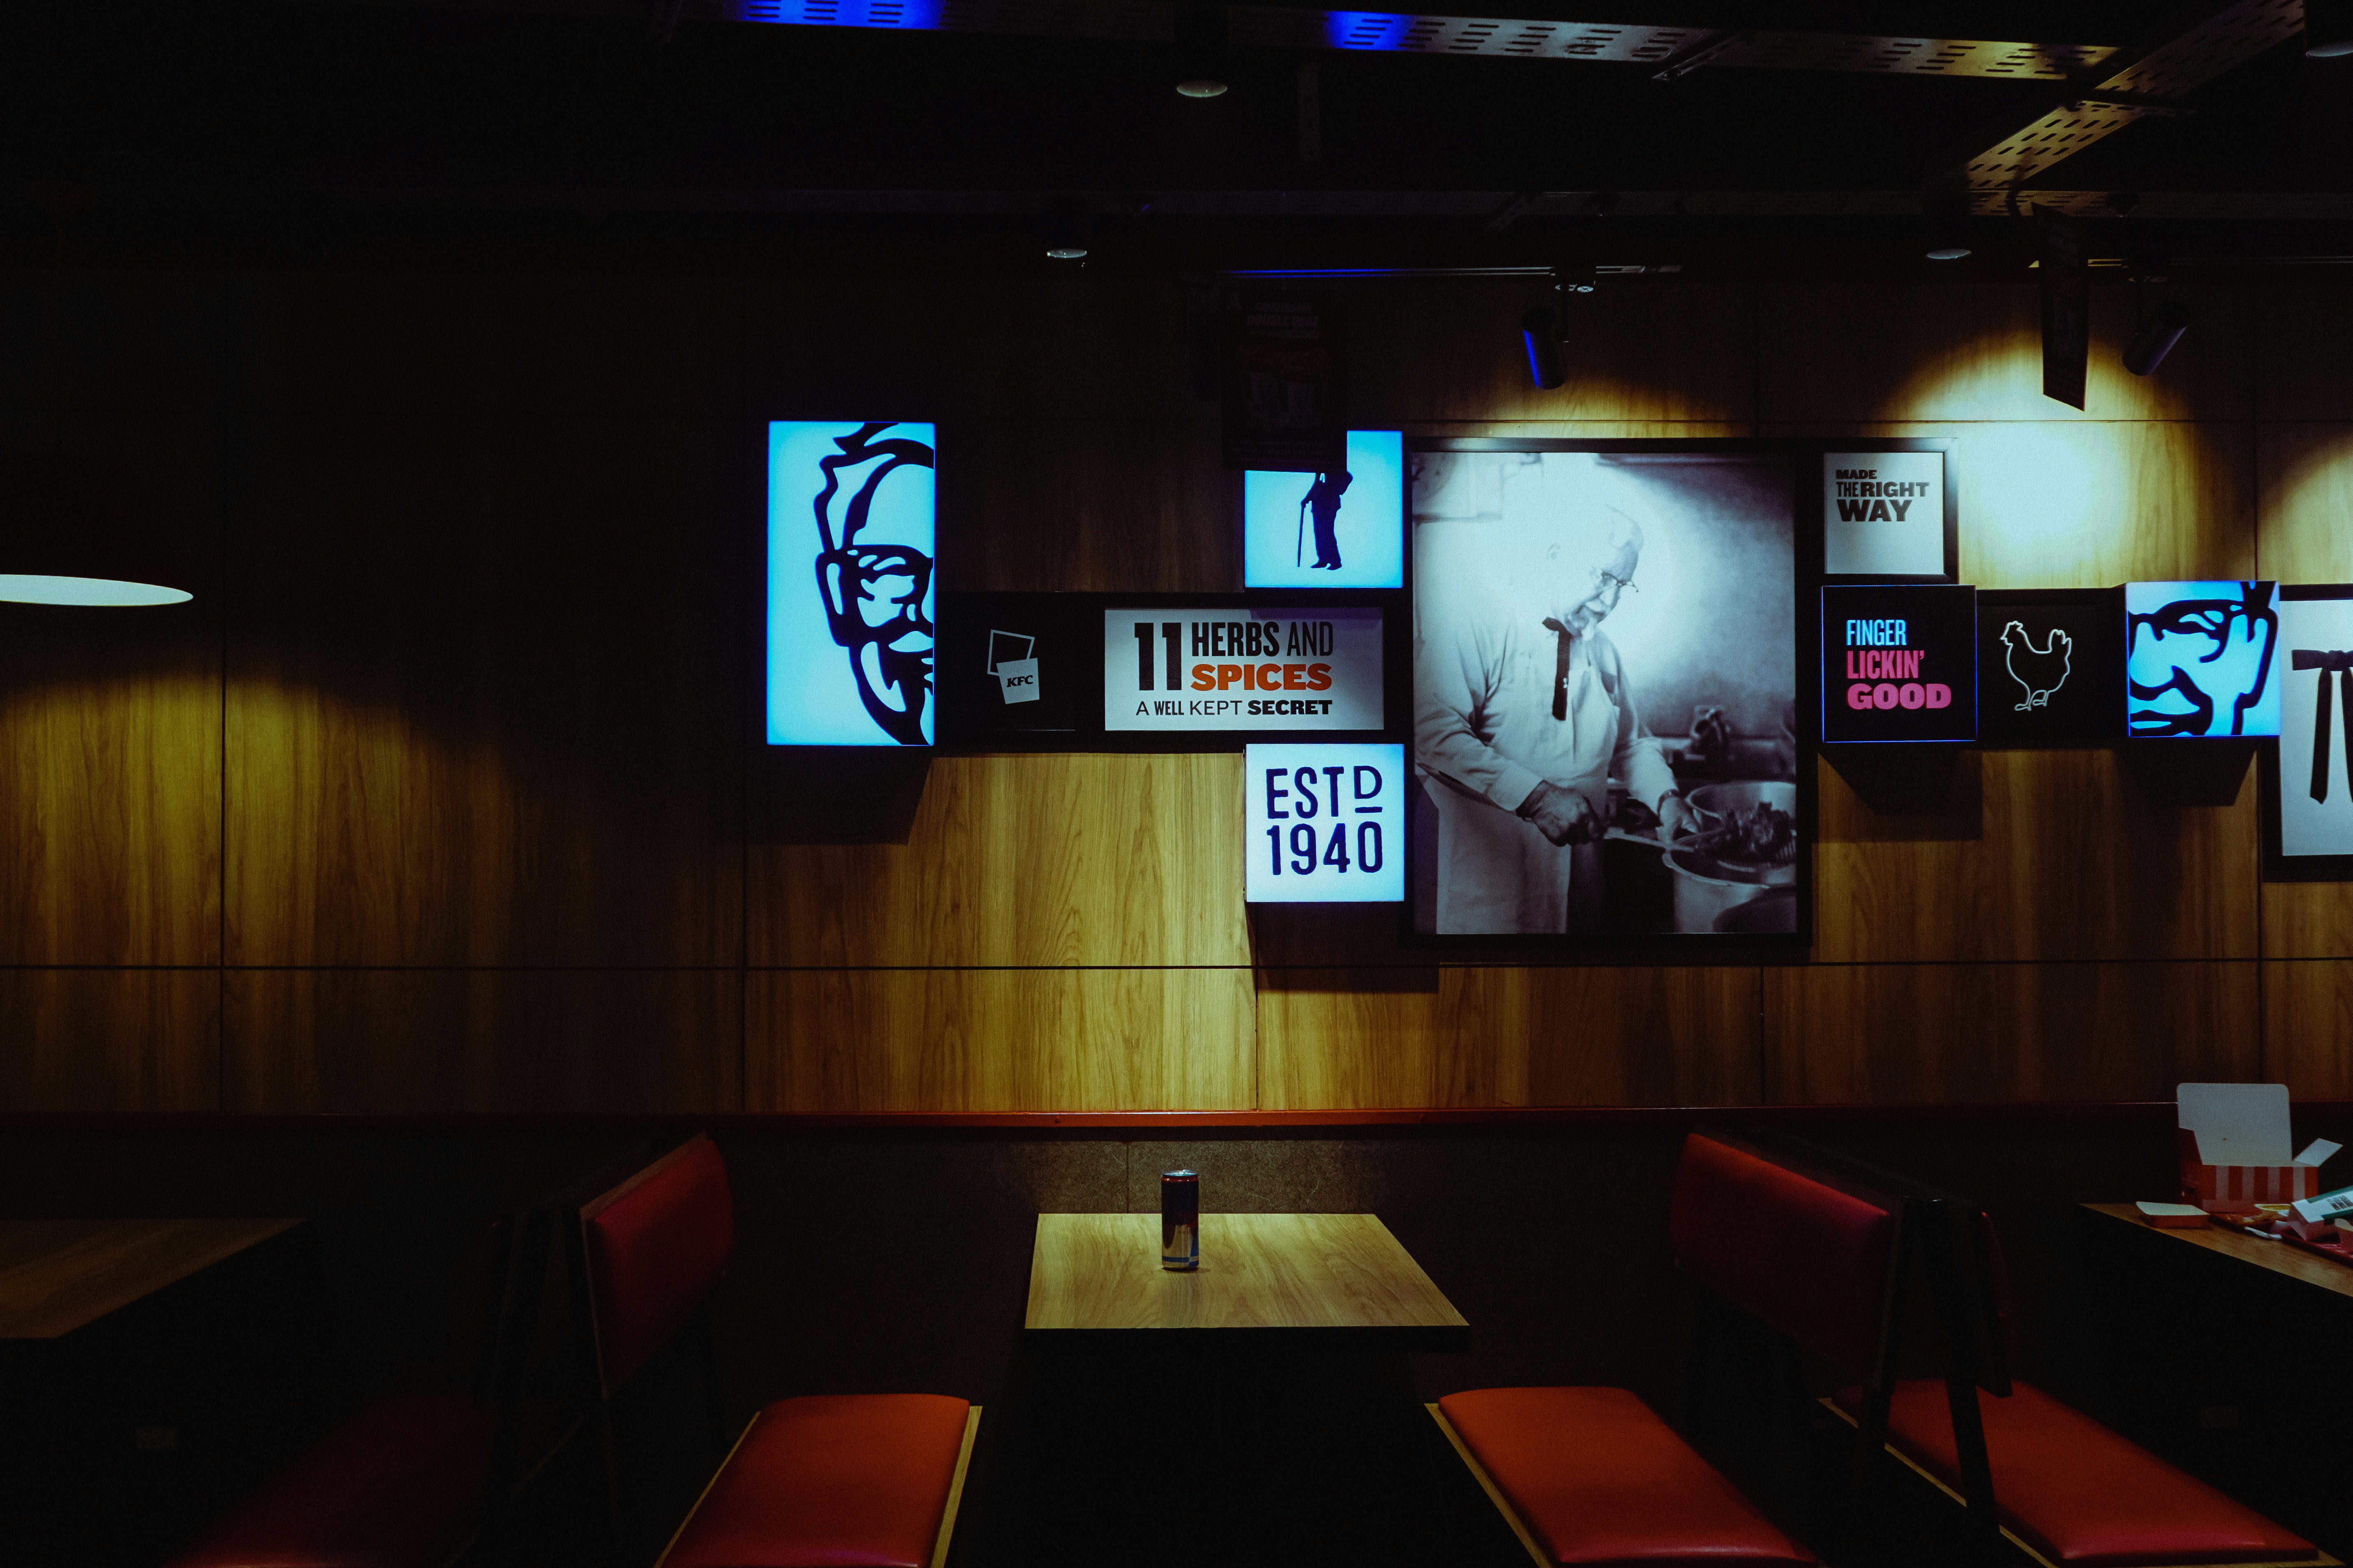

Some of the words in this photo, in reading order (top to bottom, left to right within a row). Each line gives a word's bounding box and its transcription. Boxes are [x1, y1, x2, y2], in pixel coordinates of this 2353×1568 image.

[1836, 469, 1877, 479] MADE
[1836, 481, 1859, 497] THE
[1860, 481, 1930, 497] RIGHT
[1837, 499, 1912, 522] WAY
[1846, 619, 1907, 646] FINGER
[1134, 622, 1181, 690] 11
[1192, 621, 1280, 657] HERBS
[1287, 621, 1333, 656] AND
[1847, 650, 1924, 679] LICKIN'
[1007, 675, 1033, 688] KFC
[1190, 663, 1332, 691] SPICES
[1136, 701, 1149, 715] A
[1154, 701, 1184, 715] WELL
[1190, 701, 1242, 715] KEPT
[1247, 700, 1332, 715] SECRET
[1847, 683, 1951, 710] GOOD
[1266, 821, 1383, 876] 1940
